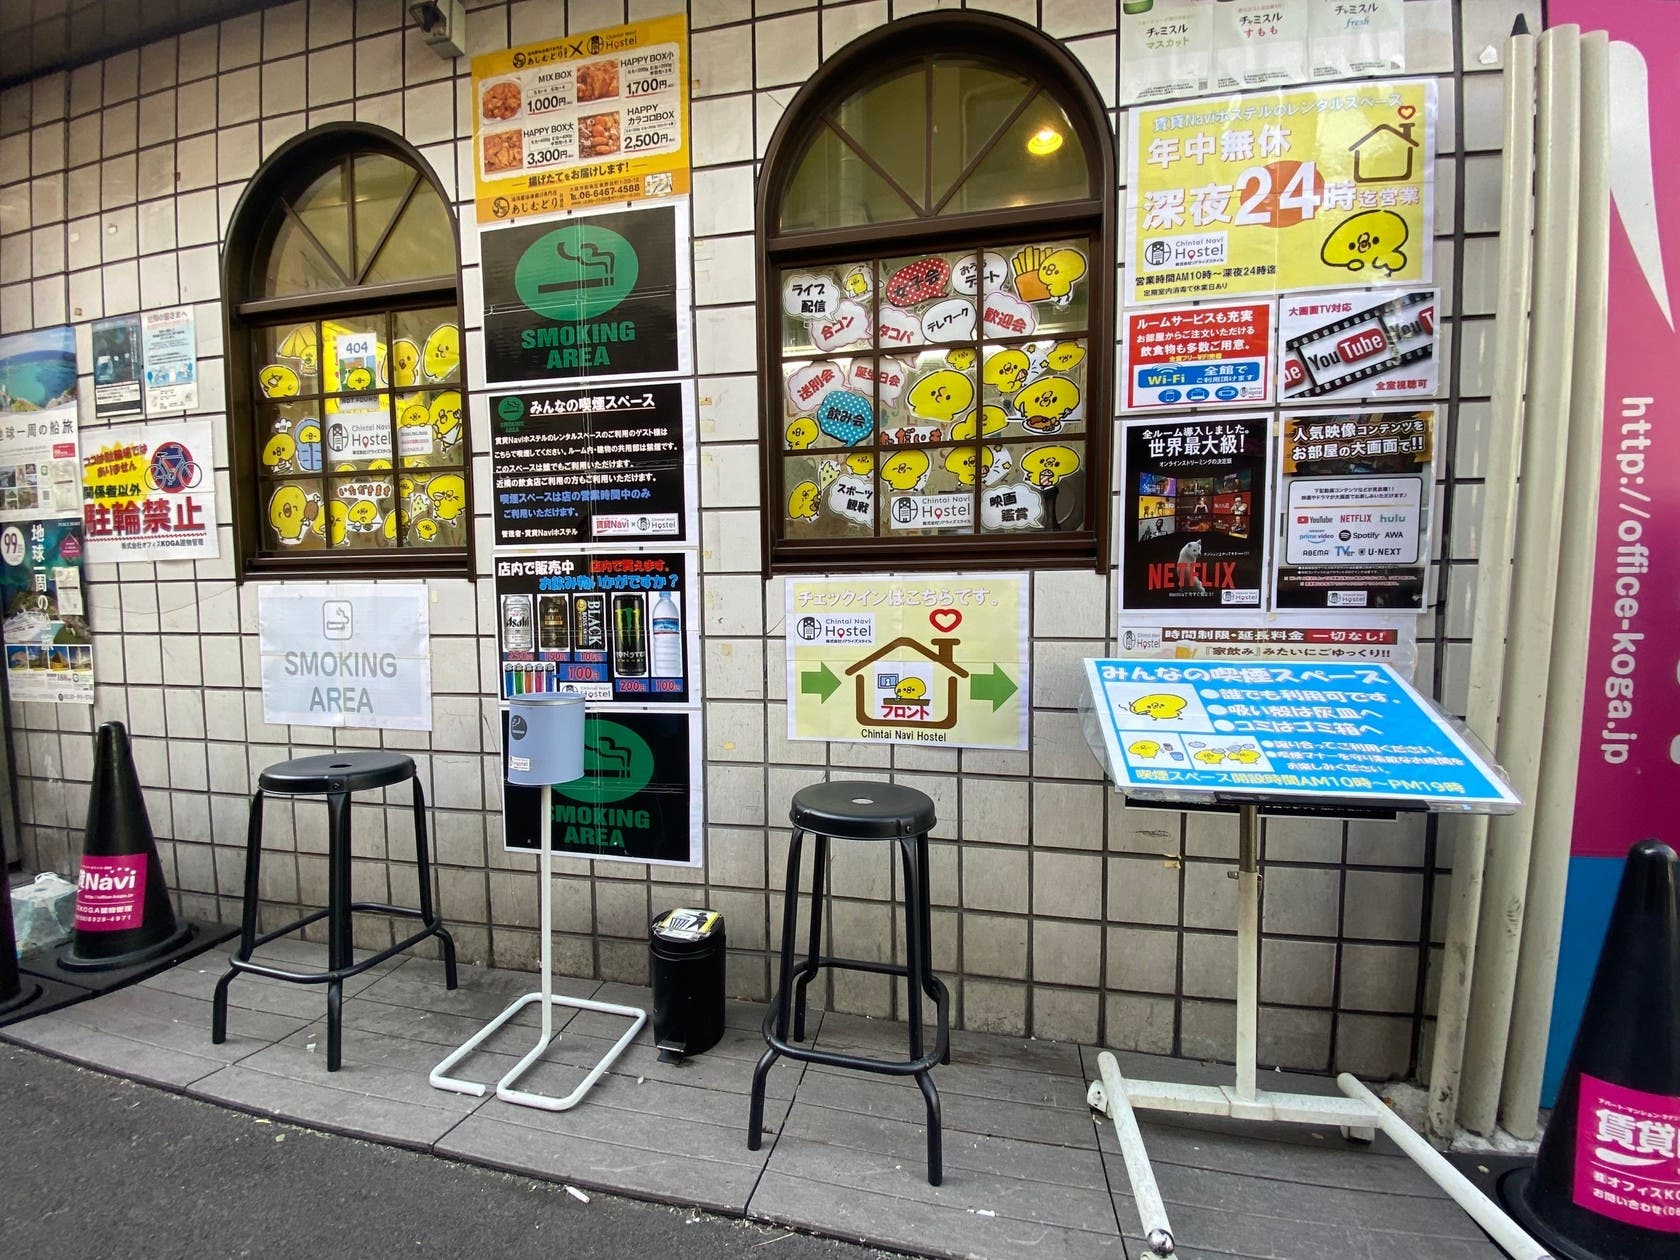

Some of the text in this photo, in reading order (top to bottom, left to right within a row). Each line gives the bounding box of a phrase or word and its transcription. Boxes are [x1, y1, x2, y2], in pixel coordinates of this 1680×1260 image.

[1335, 3, 1379, 15] チャミスル
[1239, 12, 1283, 26] チャミスル
[1344, 16, 1370, 29] fresh
[1146, 24, 1188, 38] チャミスル
[1244, 25, 1278, 37] すもも
[606, 36, 637, 50] Hostel
[1145, 36, 1189, 49] マスカット
[620, 55, 649, 68] HAPPY
[538, 70, 573, 84] MIX BOX
[626, 78, 668, 96] 1,700円
[527, 96, 566, 112] 1,000円
[627, 104, 658, 116] HAPPY
[523, 126, 550, 138] HAPPY
[624, 132, 669, 150] 2,500円
[1147, 124, 1292, 170] 年中無休
[527, 149, 568, 166] 3,300円
[1142, 160, 1420, 231] 深夜24時迄営業
[511, 198, 558, 216] あじむどり
[1175, 244, 1224, 260] Hostel
[792, 283, 825, 296] ライブ
[801, 300, 826, 313] 配信
[1288, 303, 1352, 316] 大画面TV対応
[927, 307, 968, 332] テレワーク
[984, 306, 1027, 334] 歓迎会
[1137, 309, 1253, 330] ルームサービスも充実
[521, 321, 636, 349] SMOKING
[821, 316, 854, 341] 合コン
[880, 324, 914, 344] タコパ
[1136, 326, 1255, 343] お部屋からご注文いただける
[346, 341, 369, 354] 404
[1140, 339, 1250, 357] 飲食物も多数ご用意。
[546, 347, 610, 369] AREA
[855, 365, 901, 388] 誕生日会
[1204, 365, 1247, 377] 全館で
[797, 368, 836, 401] 送別会
[1148, 374, 1185, 386] Wi-Fi
[1376, 378, 1428, 391] 全室視聴可
[529, 394, 656, 415] みんなの喫煙スペース
[827, 407, 866, 428] 飲み会
[352, 431, 391, 448] Hostel
[1142, 424, 1250, 440] 全ルーム導入しました。
[1293, 420, 1424, 442] 人気映像コンテンツを
[83, 482, 142, 500] 関係者以外
[339, 484, 391, 496] いただきます
[837, 484, 873, 499] スポーツ
[846, 499, 870, 514] 観戦
[989, 491, 1017, 508] 映画
[84, 496, 205, 537] 駐輪禁止
[503, 508, 579, 519] ご利用いただけます。
[922, 503, 970, 520] Hostel
[1001, 507, 1028, 522] 鑑賞
[1340, 514, 1372, 523] NETFLIX
[1380, 514, 1406, 522] hulu
[652, 520, 676, 530] Hostel
[4, 533, 18, 555] 99
[1353, 531, 1380, 540] Spotify
[1384, 531, 1404, 539] AWA
[498, 560, 575, 577] 店内で販売中
[1148, 562, 1237, 591] NETFLIX
[1600, 397, 1655, 765] http://office-koga.jp
[798, 588, 999, 607] チェックインはこちらです。
[506, 616, 530, 628] Asahi
[587, 601, 602, 646] BLACK
[825, 623, 872, 638] Hostel
[1136, 639, 1161, 649] Hostel
[284, 651, 398, 678] SMOKING
[1102, 665, 1390, 686] みんなの喫煙スペース
[309, 686, 374, 714] AREA
[881, 705, 930, 720] フロント
[861, 729, 947, 742] Chintai Navi Hostel
[564, 826, 624, 848] AREA
[1596, 1109, 1680, 1158] 賃貸
